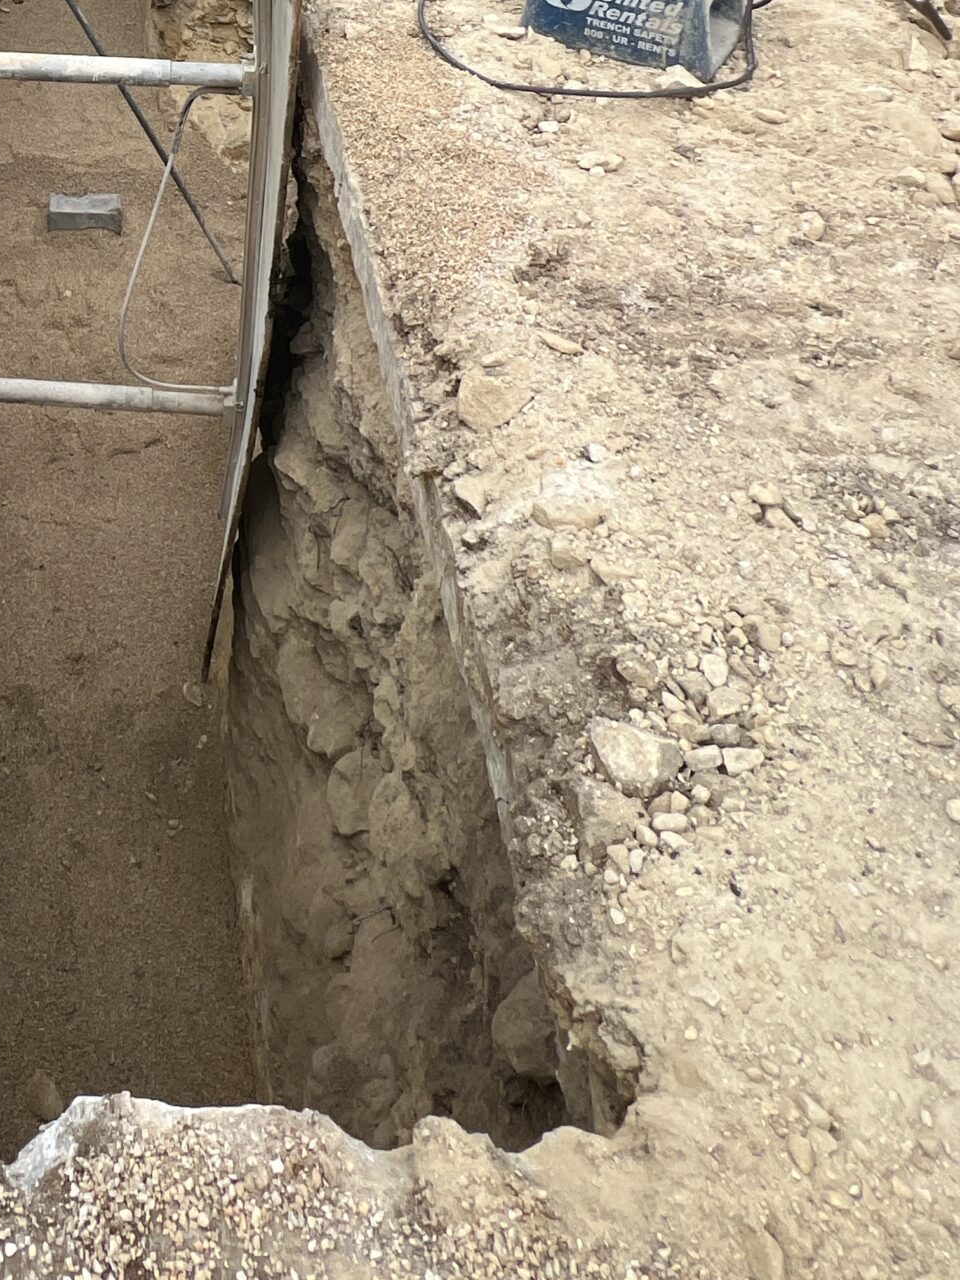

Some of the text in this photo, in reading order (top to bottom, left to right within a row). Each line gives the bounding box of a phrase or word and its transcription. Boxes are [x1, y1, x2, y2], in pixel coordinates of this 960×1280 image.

[585, 16, 679, 46] TRENCH SAFETY
[588, 0, 684, 35] Rentals
[583, 27, 604, 39] 800
[612, 34, 629, 46] UR
[637, 40, 677, 57] RENTS
